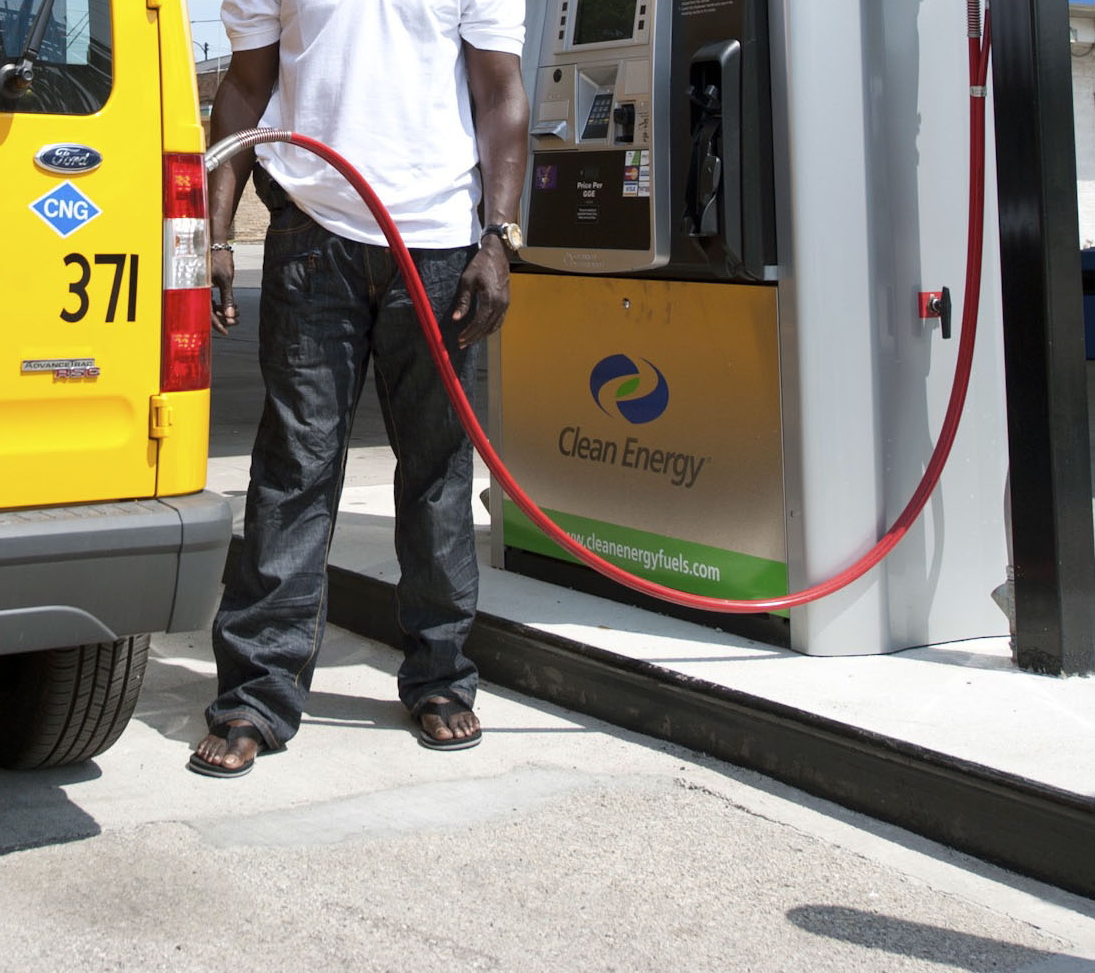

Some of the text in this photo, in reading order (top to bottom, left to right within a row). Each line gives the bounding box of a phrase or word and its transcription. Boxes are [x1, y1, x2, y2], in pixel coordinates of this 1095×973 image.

[52, 147, 90, 167] Ford
[576, 181, 603, 189] Price Per
[43, 198, 89, 220] CNG
[59, 252, 140, 324] 371
[558, 426, 705, 489] Clean Energy
